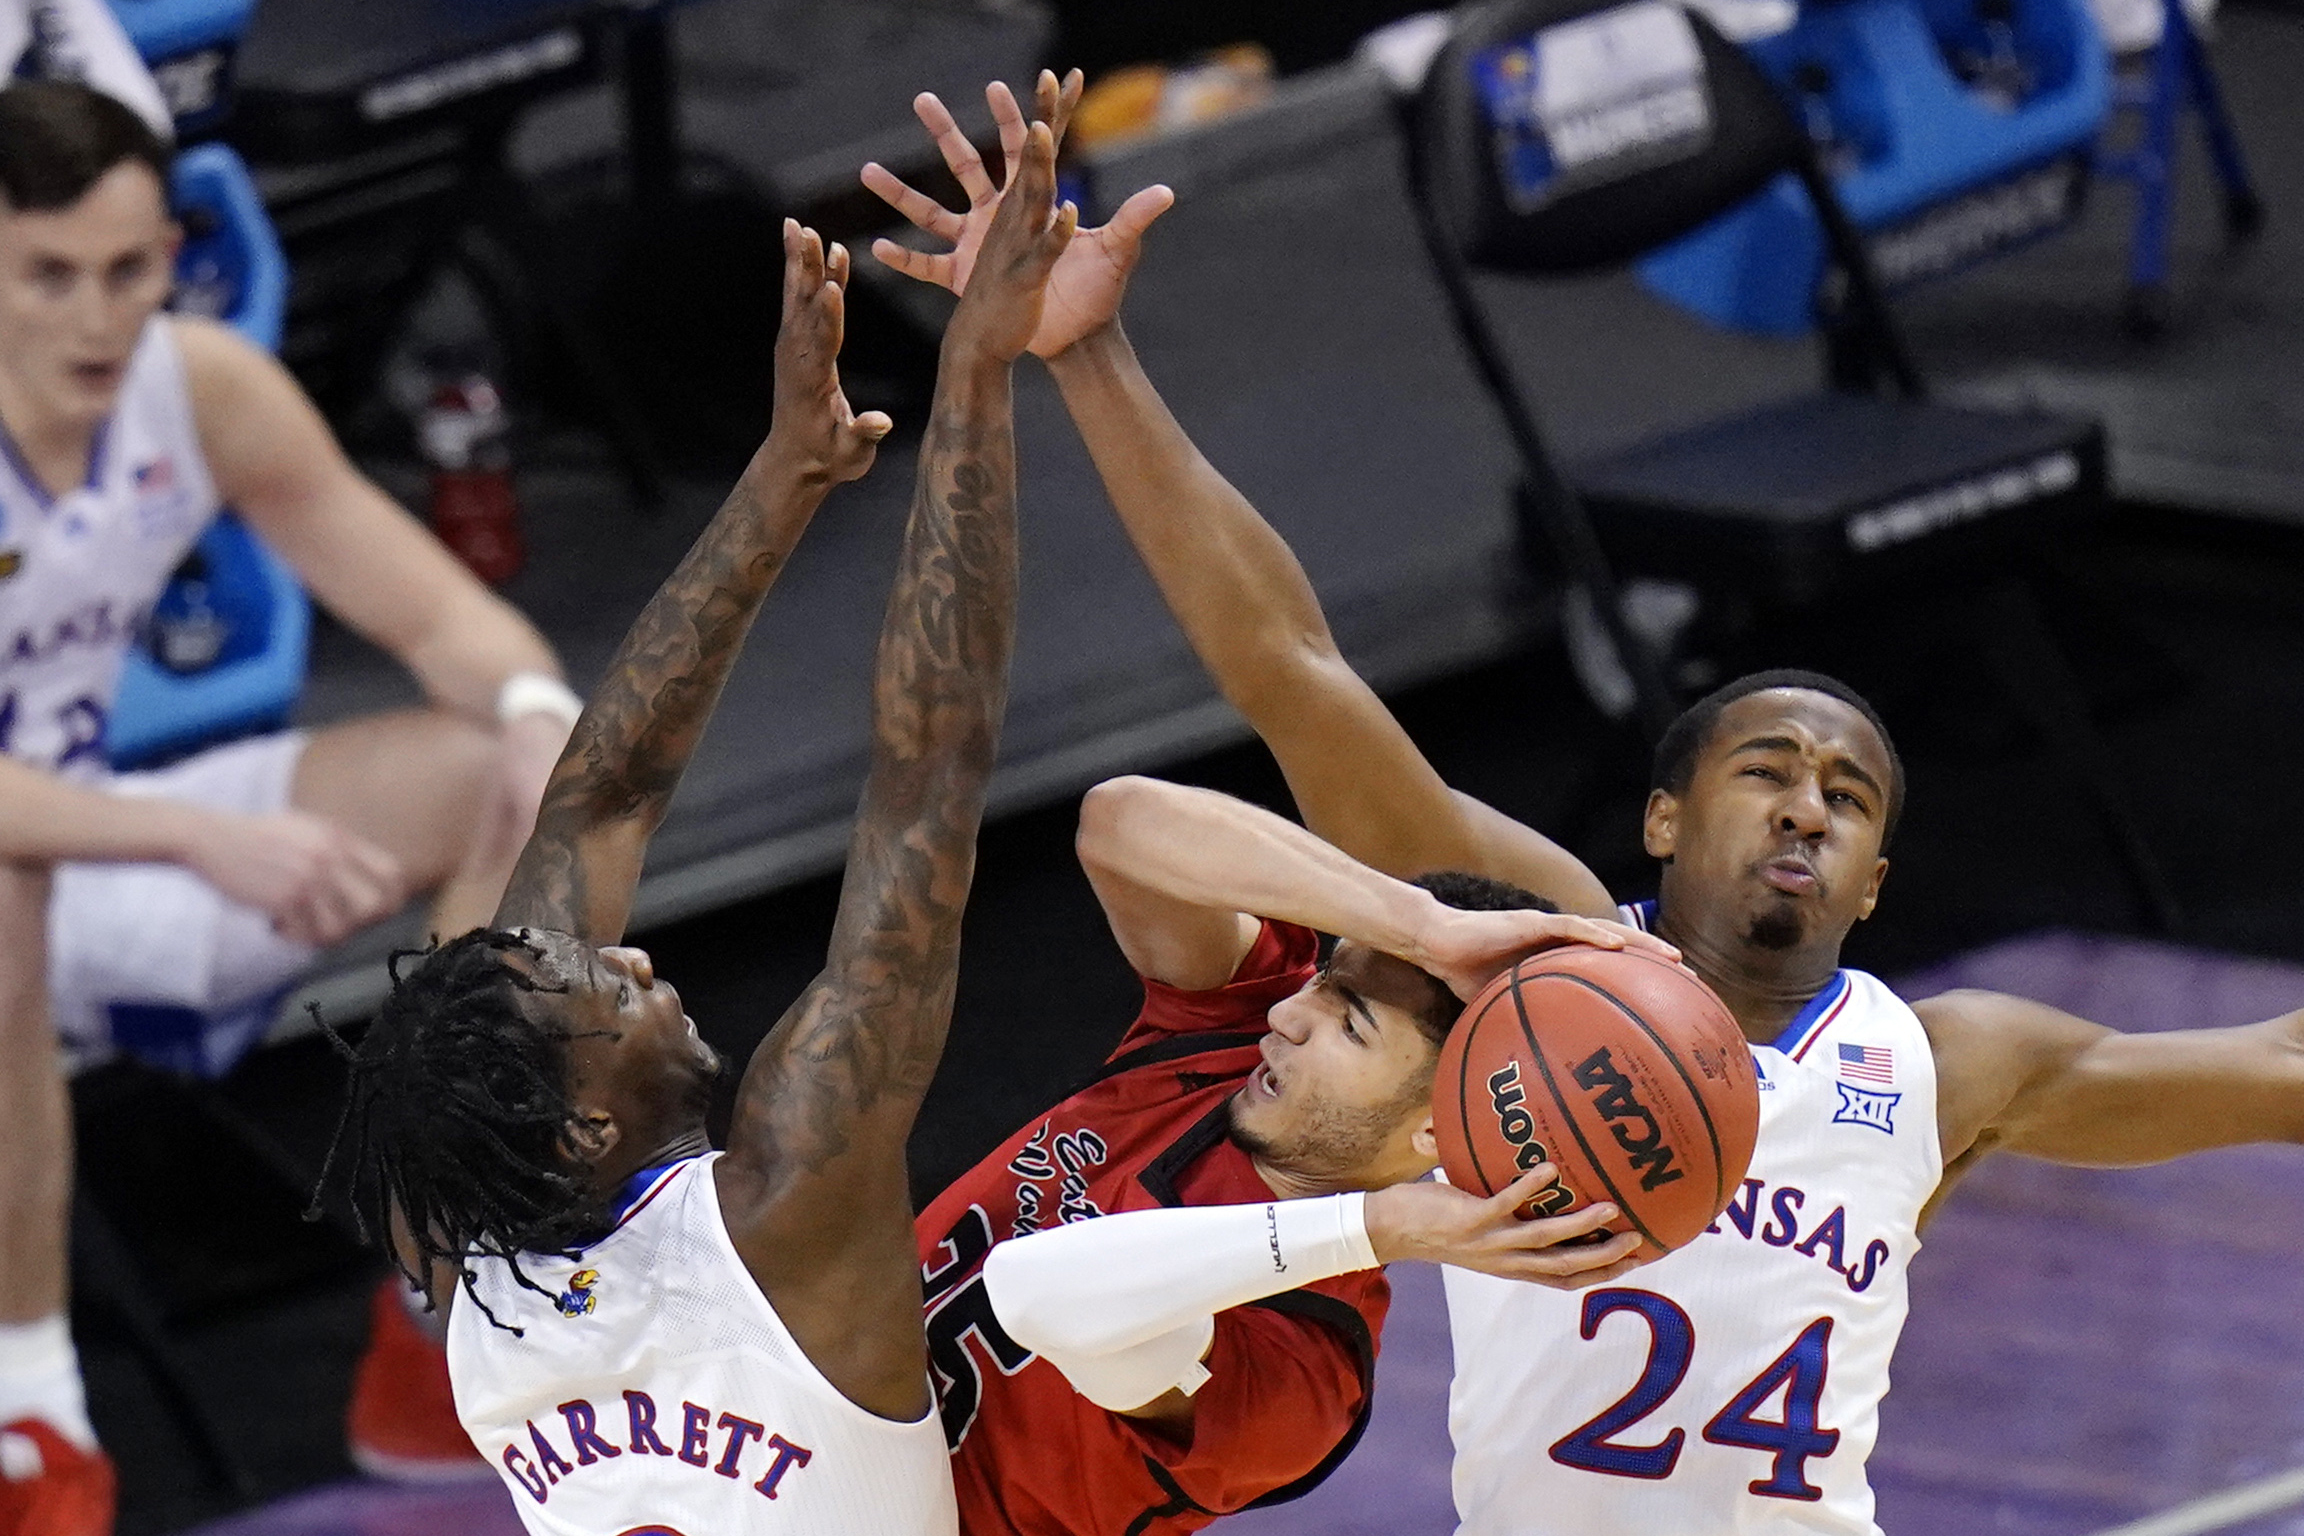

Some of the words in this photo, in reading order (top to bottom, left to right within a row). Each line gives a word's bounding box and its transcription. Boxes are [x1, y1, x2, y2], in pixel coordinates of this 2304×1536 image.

[1572, 1045, 1684, 1193] NCAA
[1266, 1205, 1283, 1267] MUELLER
[1705, 1177, 1889, 1293] NSAS
[502, 1390, 812, 1505] GARRETT
[1548, 1288, 1841, 1503] 24
